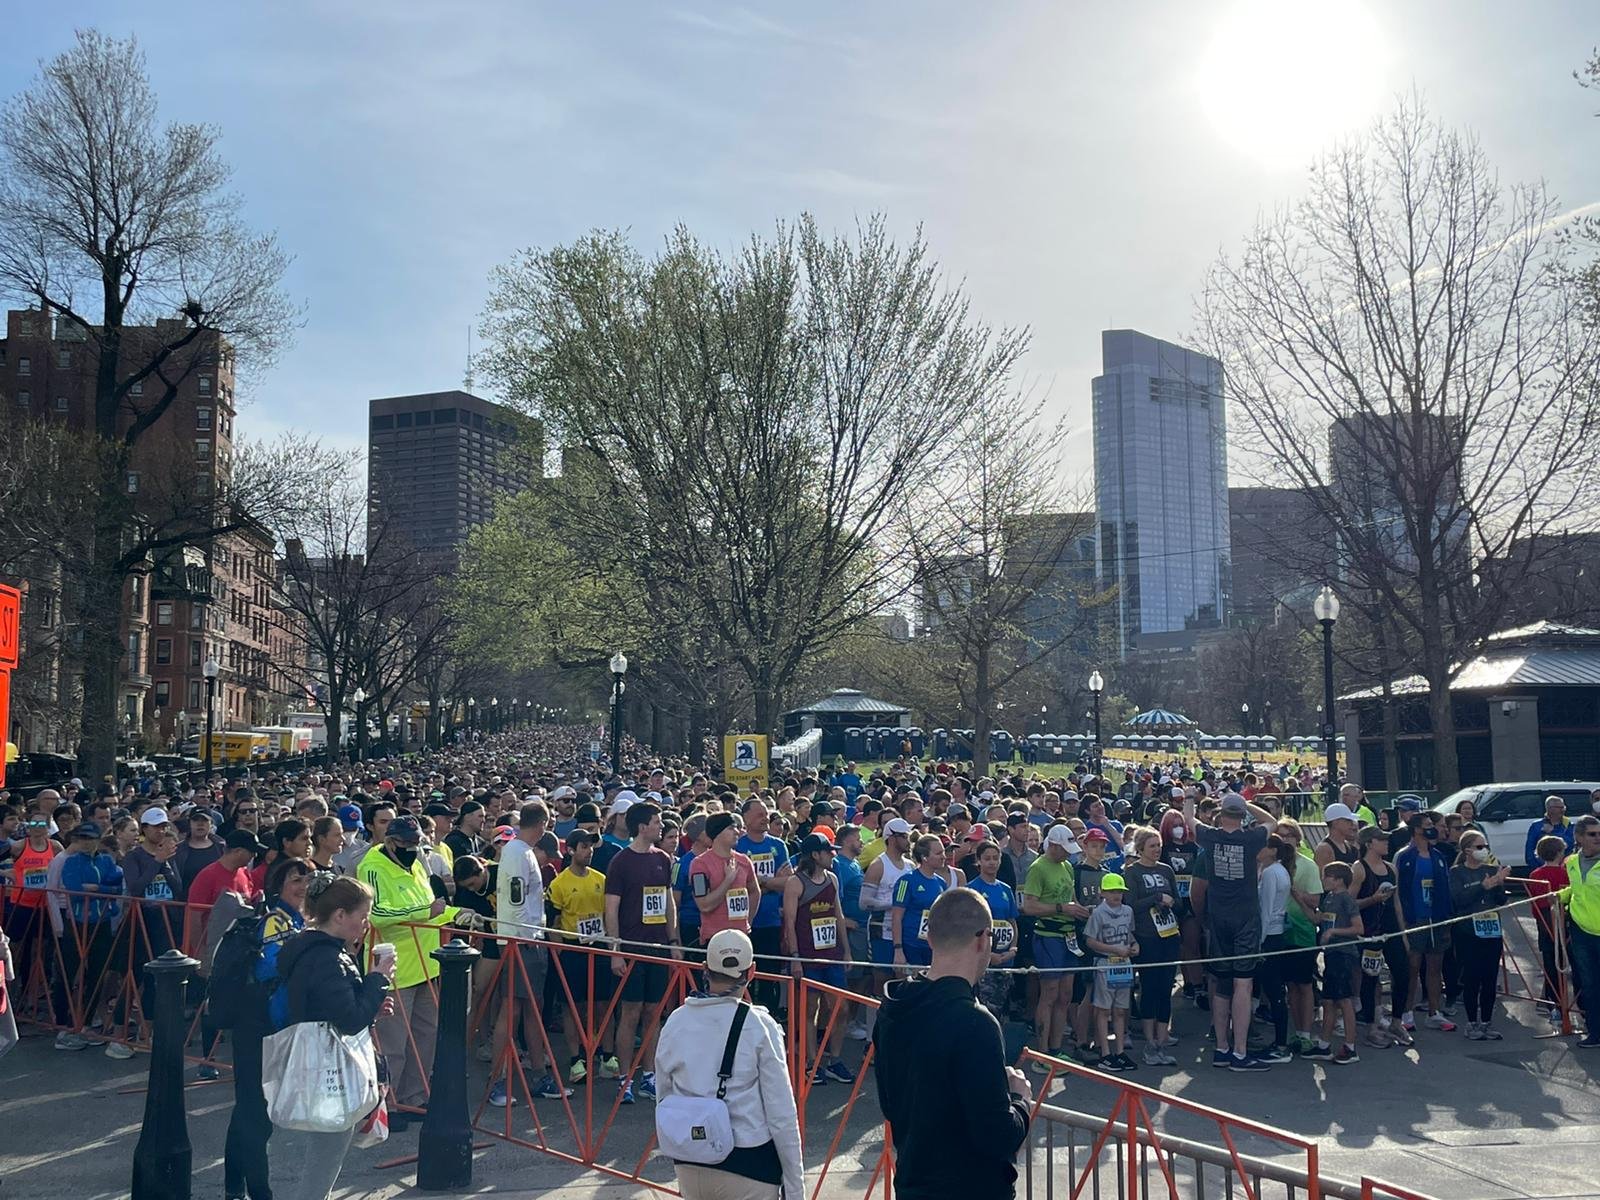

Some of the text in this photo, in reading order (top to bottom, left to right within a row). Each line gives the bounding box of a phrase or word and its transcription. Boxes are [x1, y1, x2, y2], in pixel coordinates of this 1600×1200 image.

[303, 721, 324, 729] Ryder
[646, 895, 662, 911] 661
[579, 919, 602, 935] 1542
